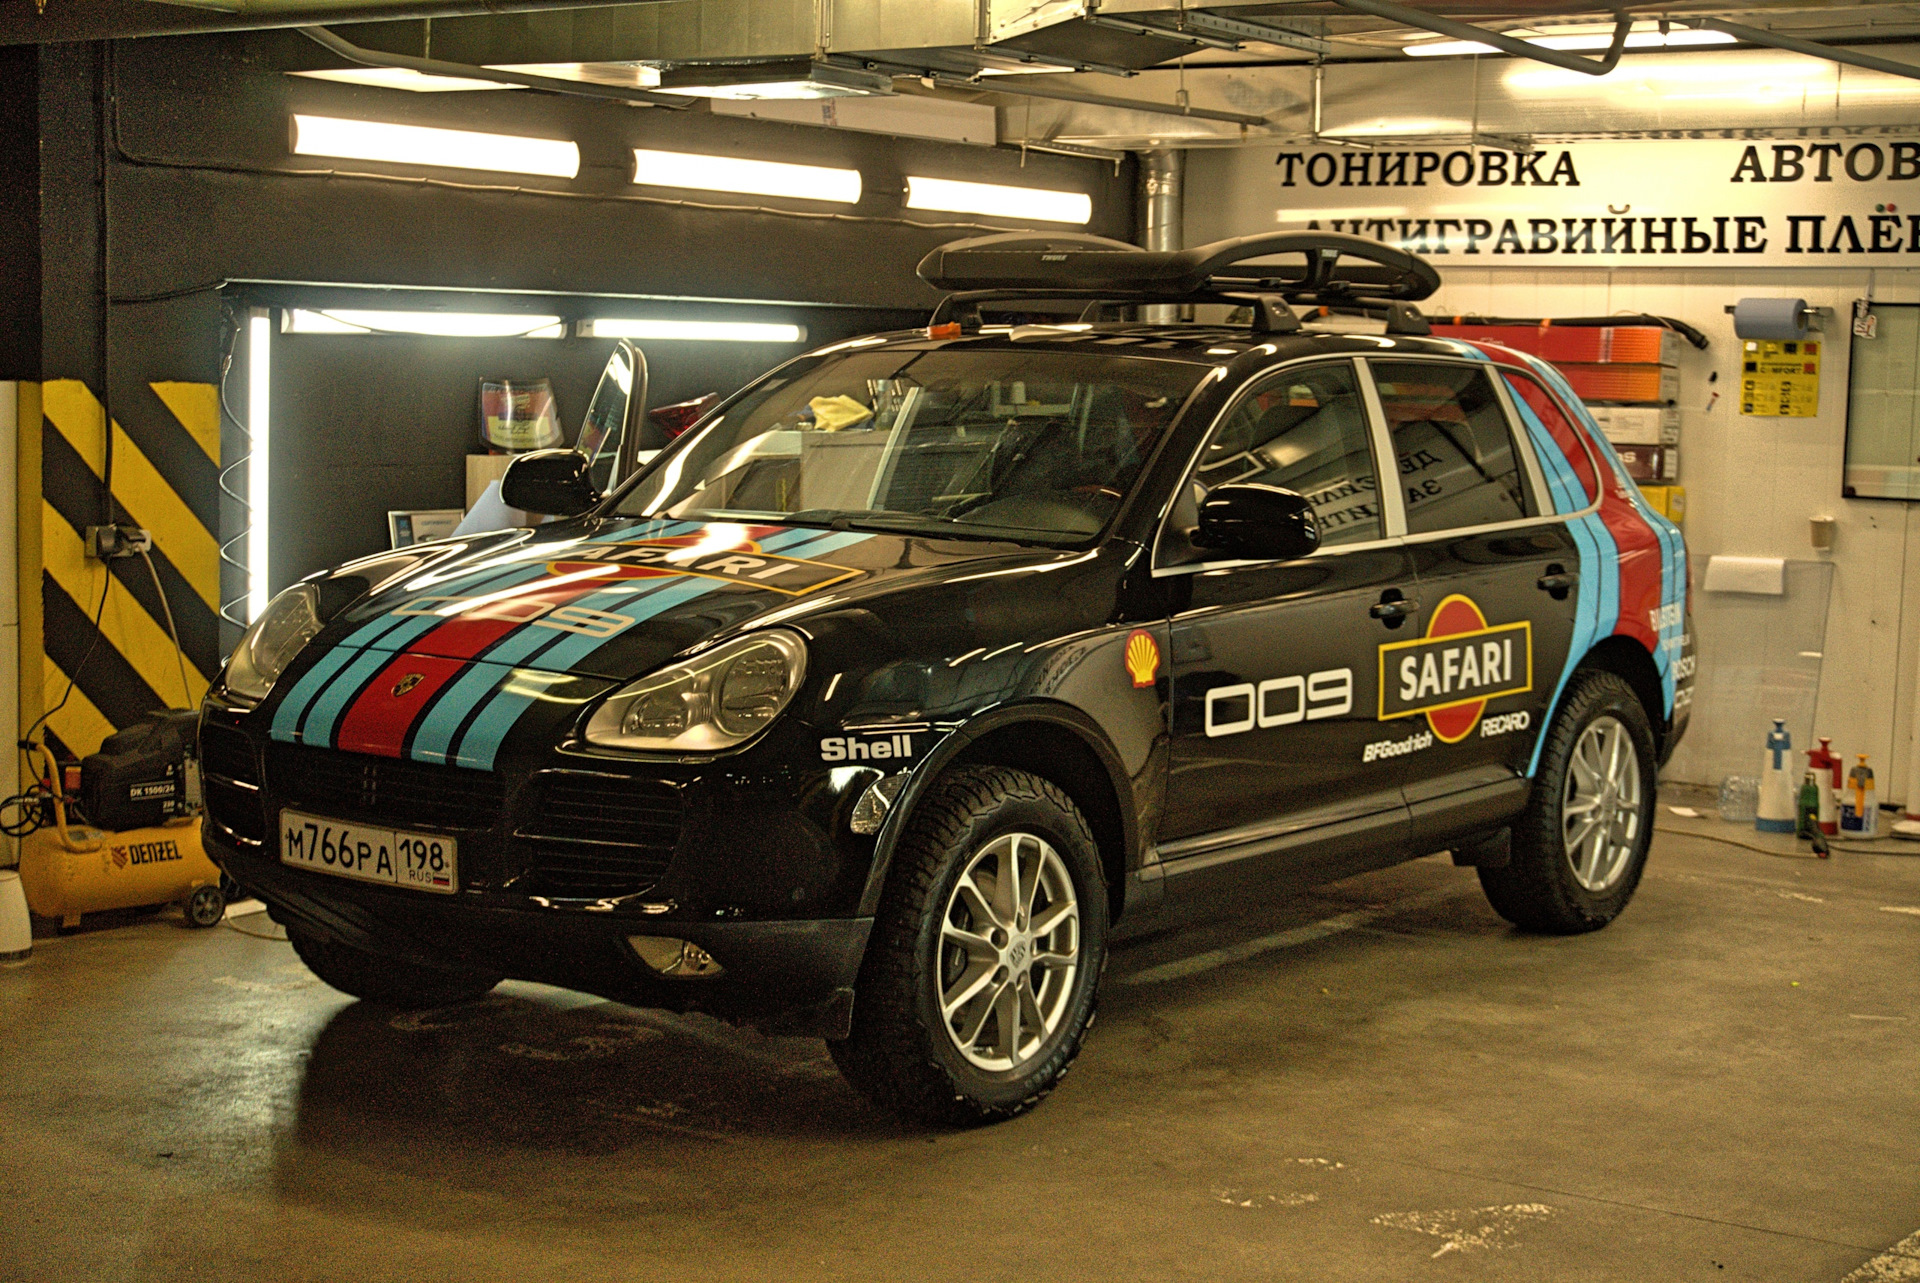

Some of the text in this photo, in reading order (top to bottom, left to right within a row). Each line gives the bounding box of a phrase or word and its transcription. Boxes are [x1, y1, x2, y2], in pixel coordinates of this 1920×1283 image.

[1276, 150, 1581, 187] ТОНИРОВКА
[1399, 638, 1512, 701] SAFARI
[1205, 667, 1353, 737] 009
[1480, 711, 1531, 738] RECARO
[820, 734, 912, 762] Shell
[1362, 730, 1434, 763] BFGoodrich
[129, 840, 183, 865] DENZEL
[399, 839, 444, 872] 198
[408, 869, 432, 884] RUS
